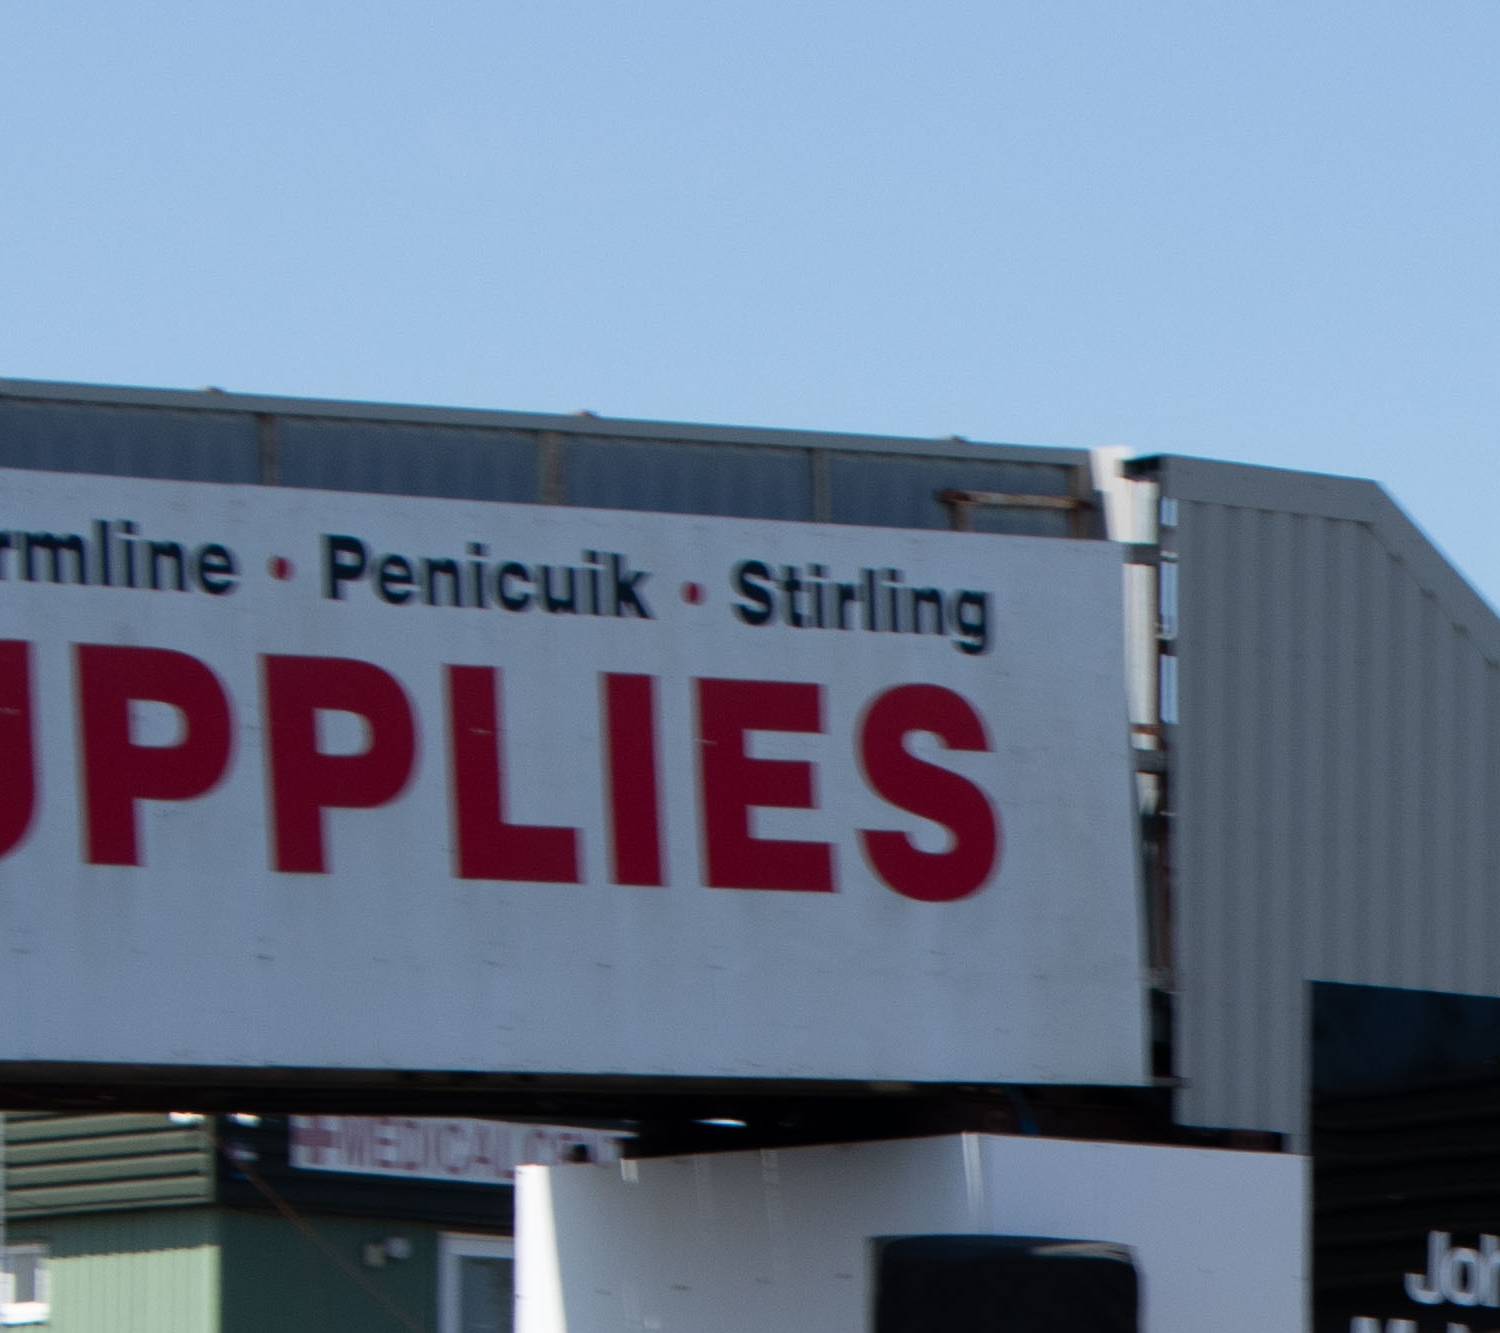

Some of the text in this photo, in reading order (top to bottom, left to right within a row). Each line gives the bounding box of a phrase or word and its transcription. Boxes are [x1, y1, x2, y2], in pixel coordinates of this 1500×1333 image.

[322, 533, 652, 620] Penicuik
[732, 557, 992, 656] Stirling
[338, 1116, 514, 1180] MEDICAL
